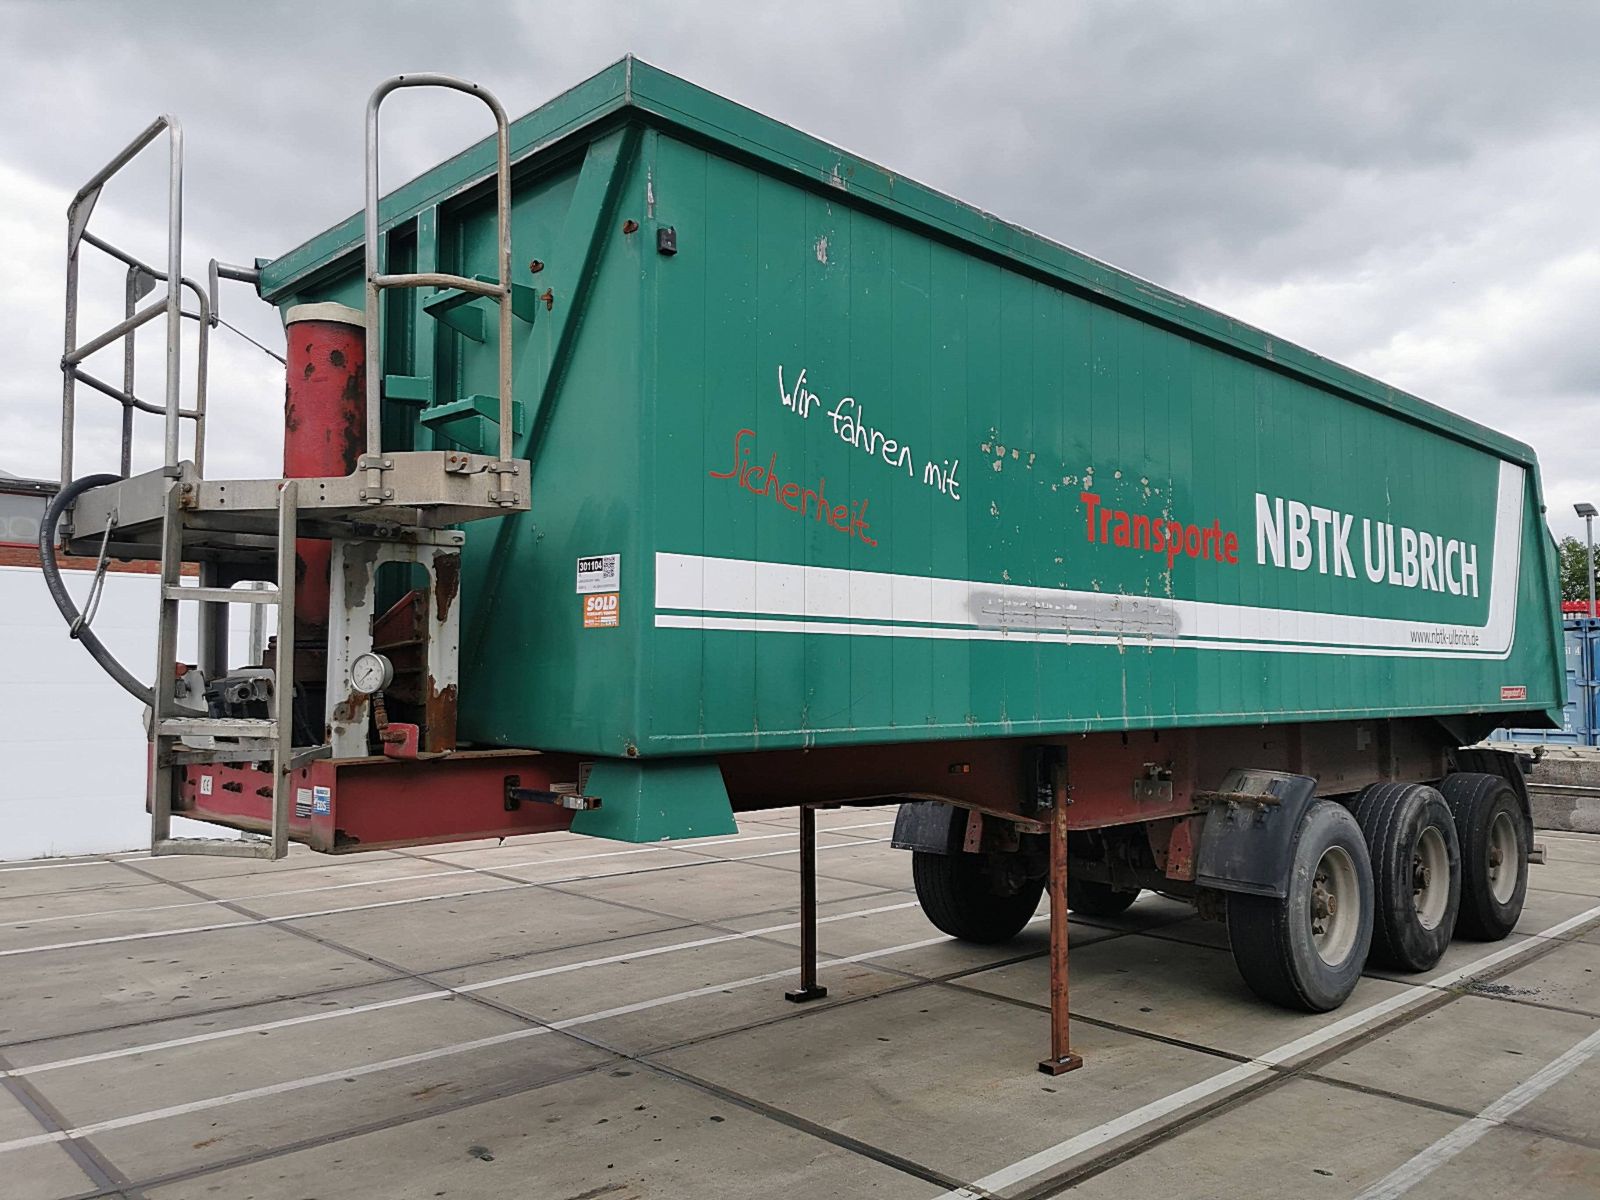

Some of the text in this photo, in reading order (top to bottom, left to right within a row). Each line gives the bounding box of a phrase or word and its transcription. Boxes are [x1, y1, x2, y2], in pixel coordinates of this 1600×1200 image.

[778, 364, 961, 500] Wir fahren mit
[1080, 492, 1239, 570] Transporte
[1255, 492, 1479, 598] NBTK ULBRICH
[579, 561, 602, 571] 301104
[587, 595, 617, 611] SOLD
[1410, 628, 1479, 646] www.nbtk-ulbrich.de
